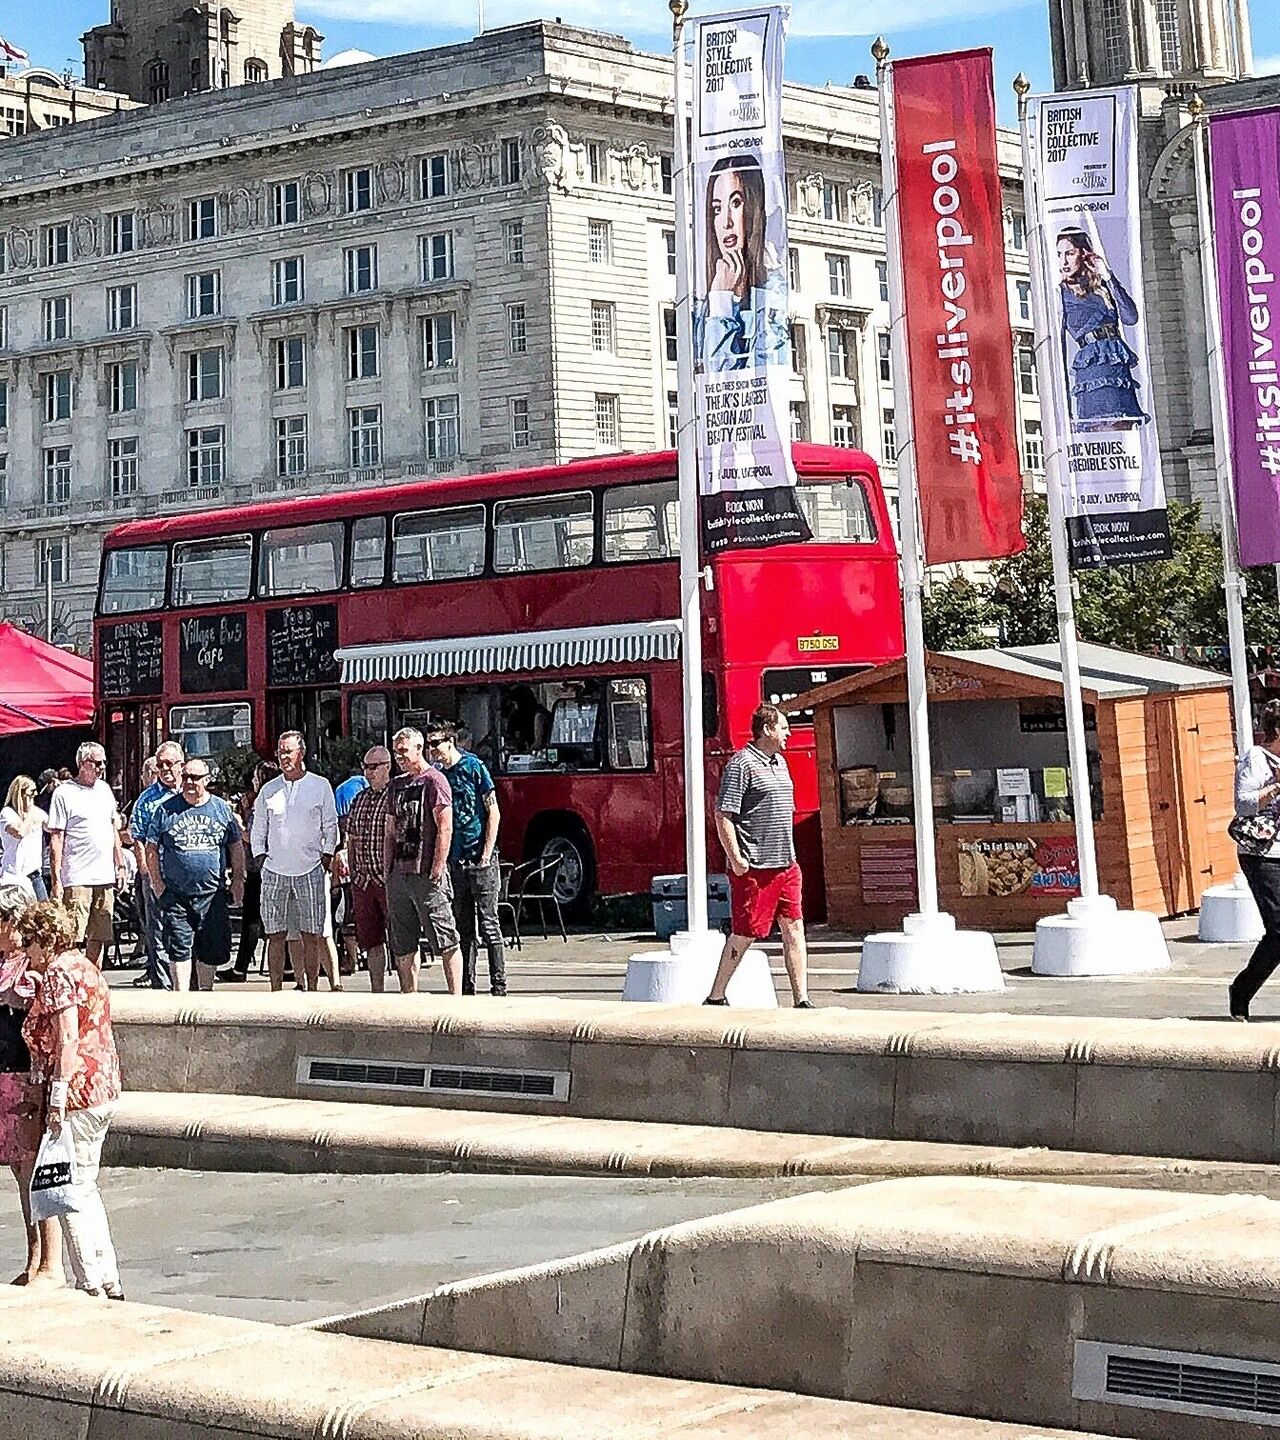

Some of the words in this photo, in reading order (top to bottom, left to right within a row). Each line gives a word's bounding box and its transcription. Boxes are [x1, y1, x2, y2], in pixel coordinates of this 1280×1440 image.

[706, 29, 737, 47] BRITISH
[706, 46, 732, 62] STYLE
[706, 57, 753, 77] COLLECTIVE
[706, 78, 724, 93] 2017
[1048, 107, 1082, 122] BRITISH
[1048, 121, 1074, 135] STYLE
[1048, 132, 1099, 149] COLLECTIVE
[1048, 149, 1067, 162] 2017
[922, 139, 982, 465] #itsliverpool
[706, 395, 720, 411] THE
[1084, 441, 1126, 456] VENUES.
[1109, 456, 1140, 470] STYLE.
[745, 498, 764, 512] NOW
[1104, 492, 1141, 504] LIVERPOOL
[1093, 522, 1110, 533] BOOK
[1111, 521, 1130, 532] NOW
[182, 618, 216, 651] Village
[219, 616, 243, 646] Bus
[197, 647, 224, 670] Cafe
